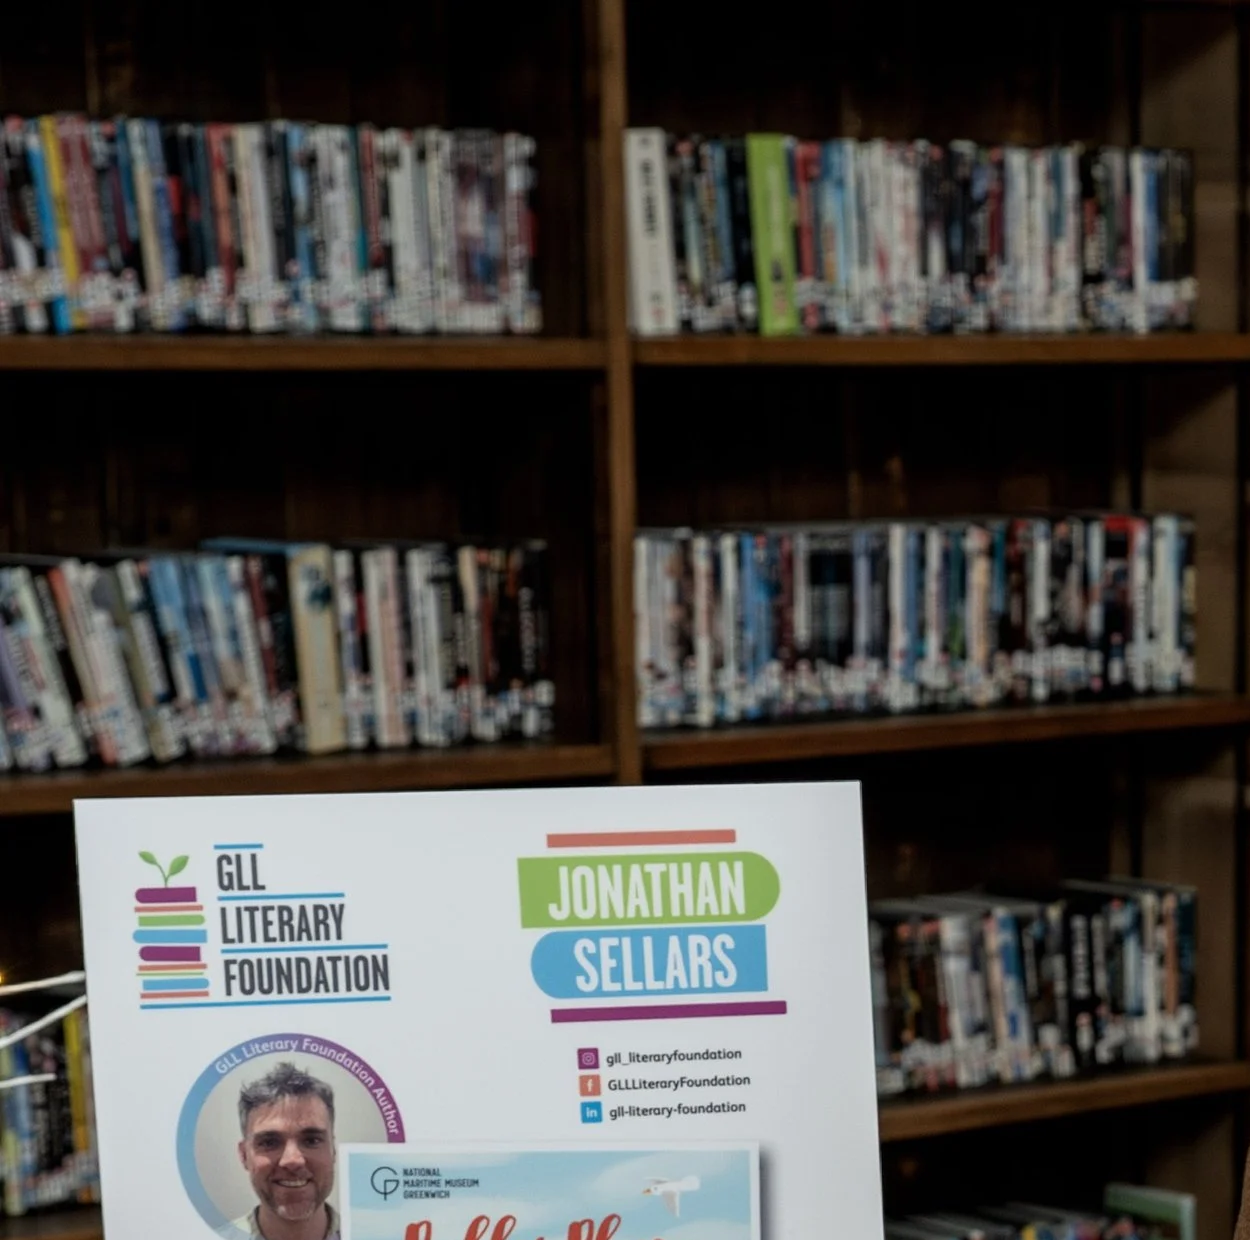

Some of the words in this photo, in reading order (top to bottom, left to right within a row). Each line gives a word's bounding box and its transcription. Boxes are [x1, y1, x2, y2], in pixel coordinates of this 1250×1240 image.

[216, 853, 266, 891] GLL
[548, 860, 746, 920] JONATHAN
[220, 904, 345, 944] LITERARY
[224, 954, 390, 996] FOUNDATION
[573, 933, 738, 993] SELLARS
[606, 1048, 742, 1067] gll_literaryfoundation
[214, 1055, 242, 1075] GLL
[243, 1038, 299, 1058] Literary
[302, 1038, 376, 1088] Foundation
[372, 1087, 399, 1135] Author
[607, 1075, 751, 1092] GLLLiteraryFoundation
[609, 1102, 746, 1121] gll-literary-foundation
[402, 1167, 442, 1177] NATIONAL
[403, 1178, 442, 1189] MARITIME
[445, 1178, 480, 1188] MUSEUM
[403, 1190, 451, 1199] GREENWICH
